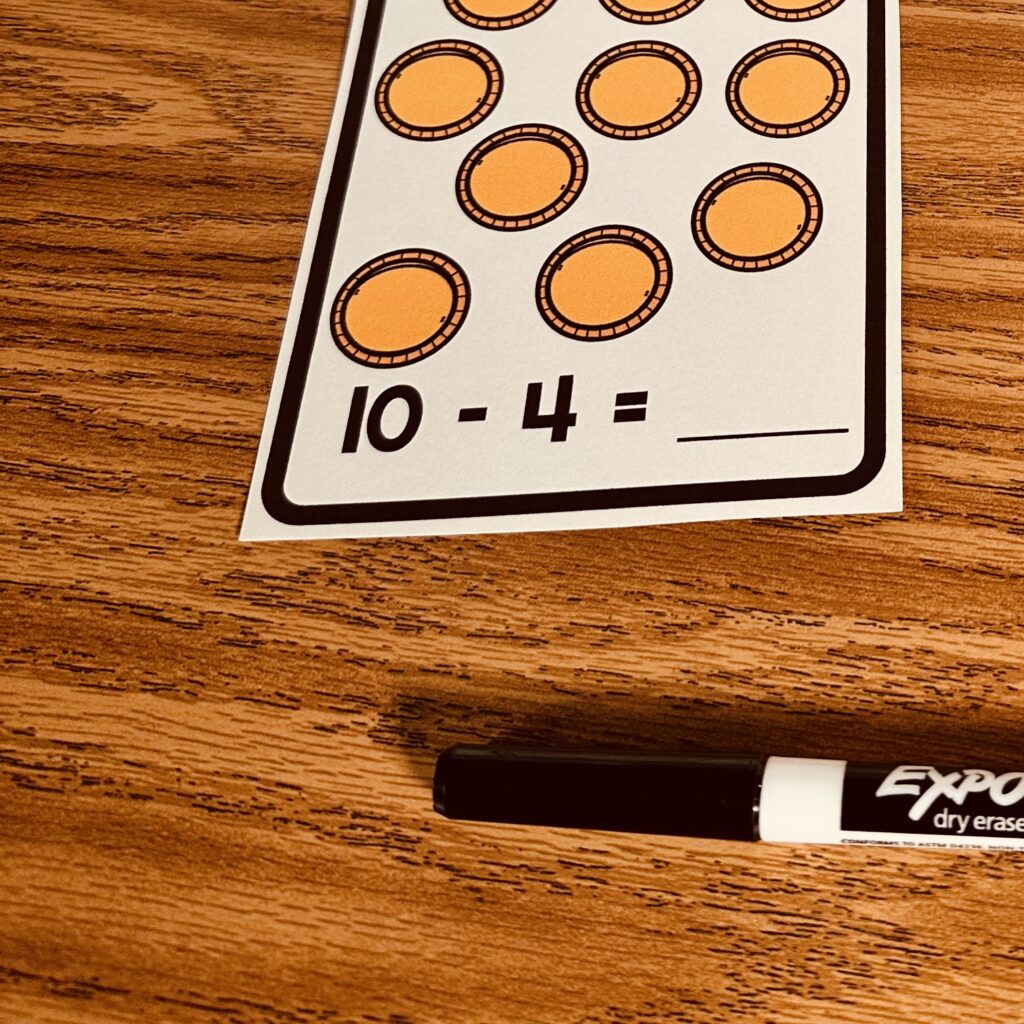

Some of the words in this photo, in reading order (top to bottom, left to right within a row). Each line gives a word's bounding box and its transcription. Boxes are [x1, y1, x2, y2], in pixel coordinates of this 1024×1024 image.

[341, 383, 424, 454] 10
[521, 374, 577, 443] 4
[933, 808, 970, 834] dry
